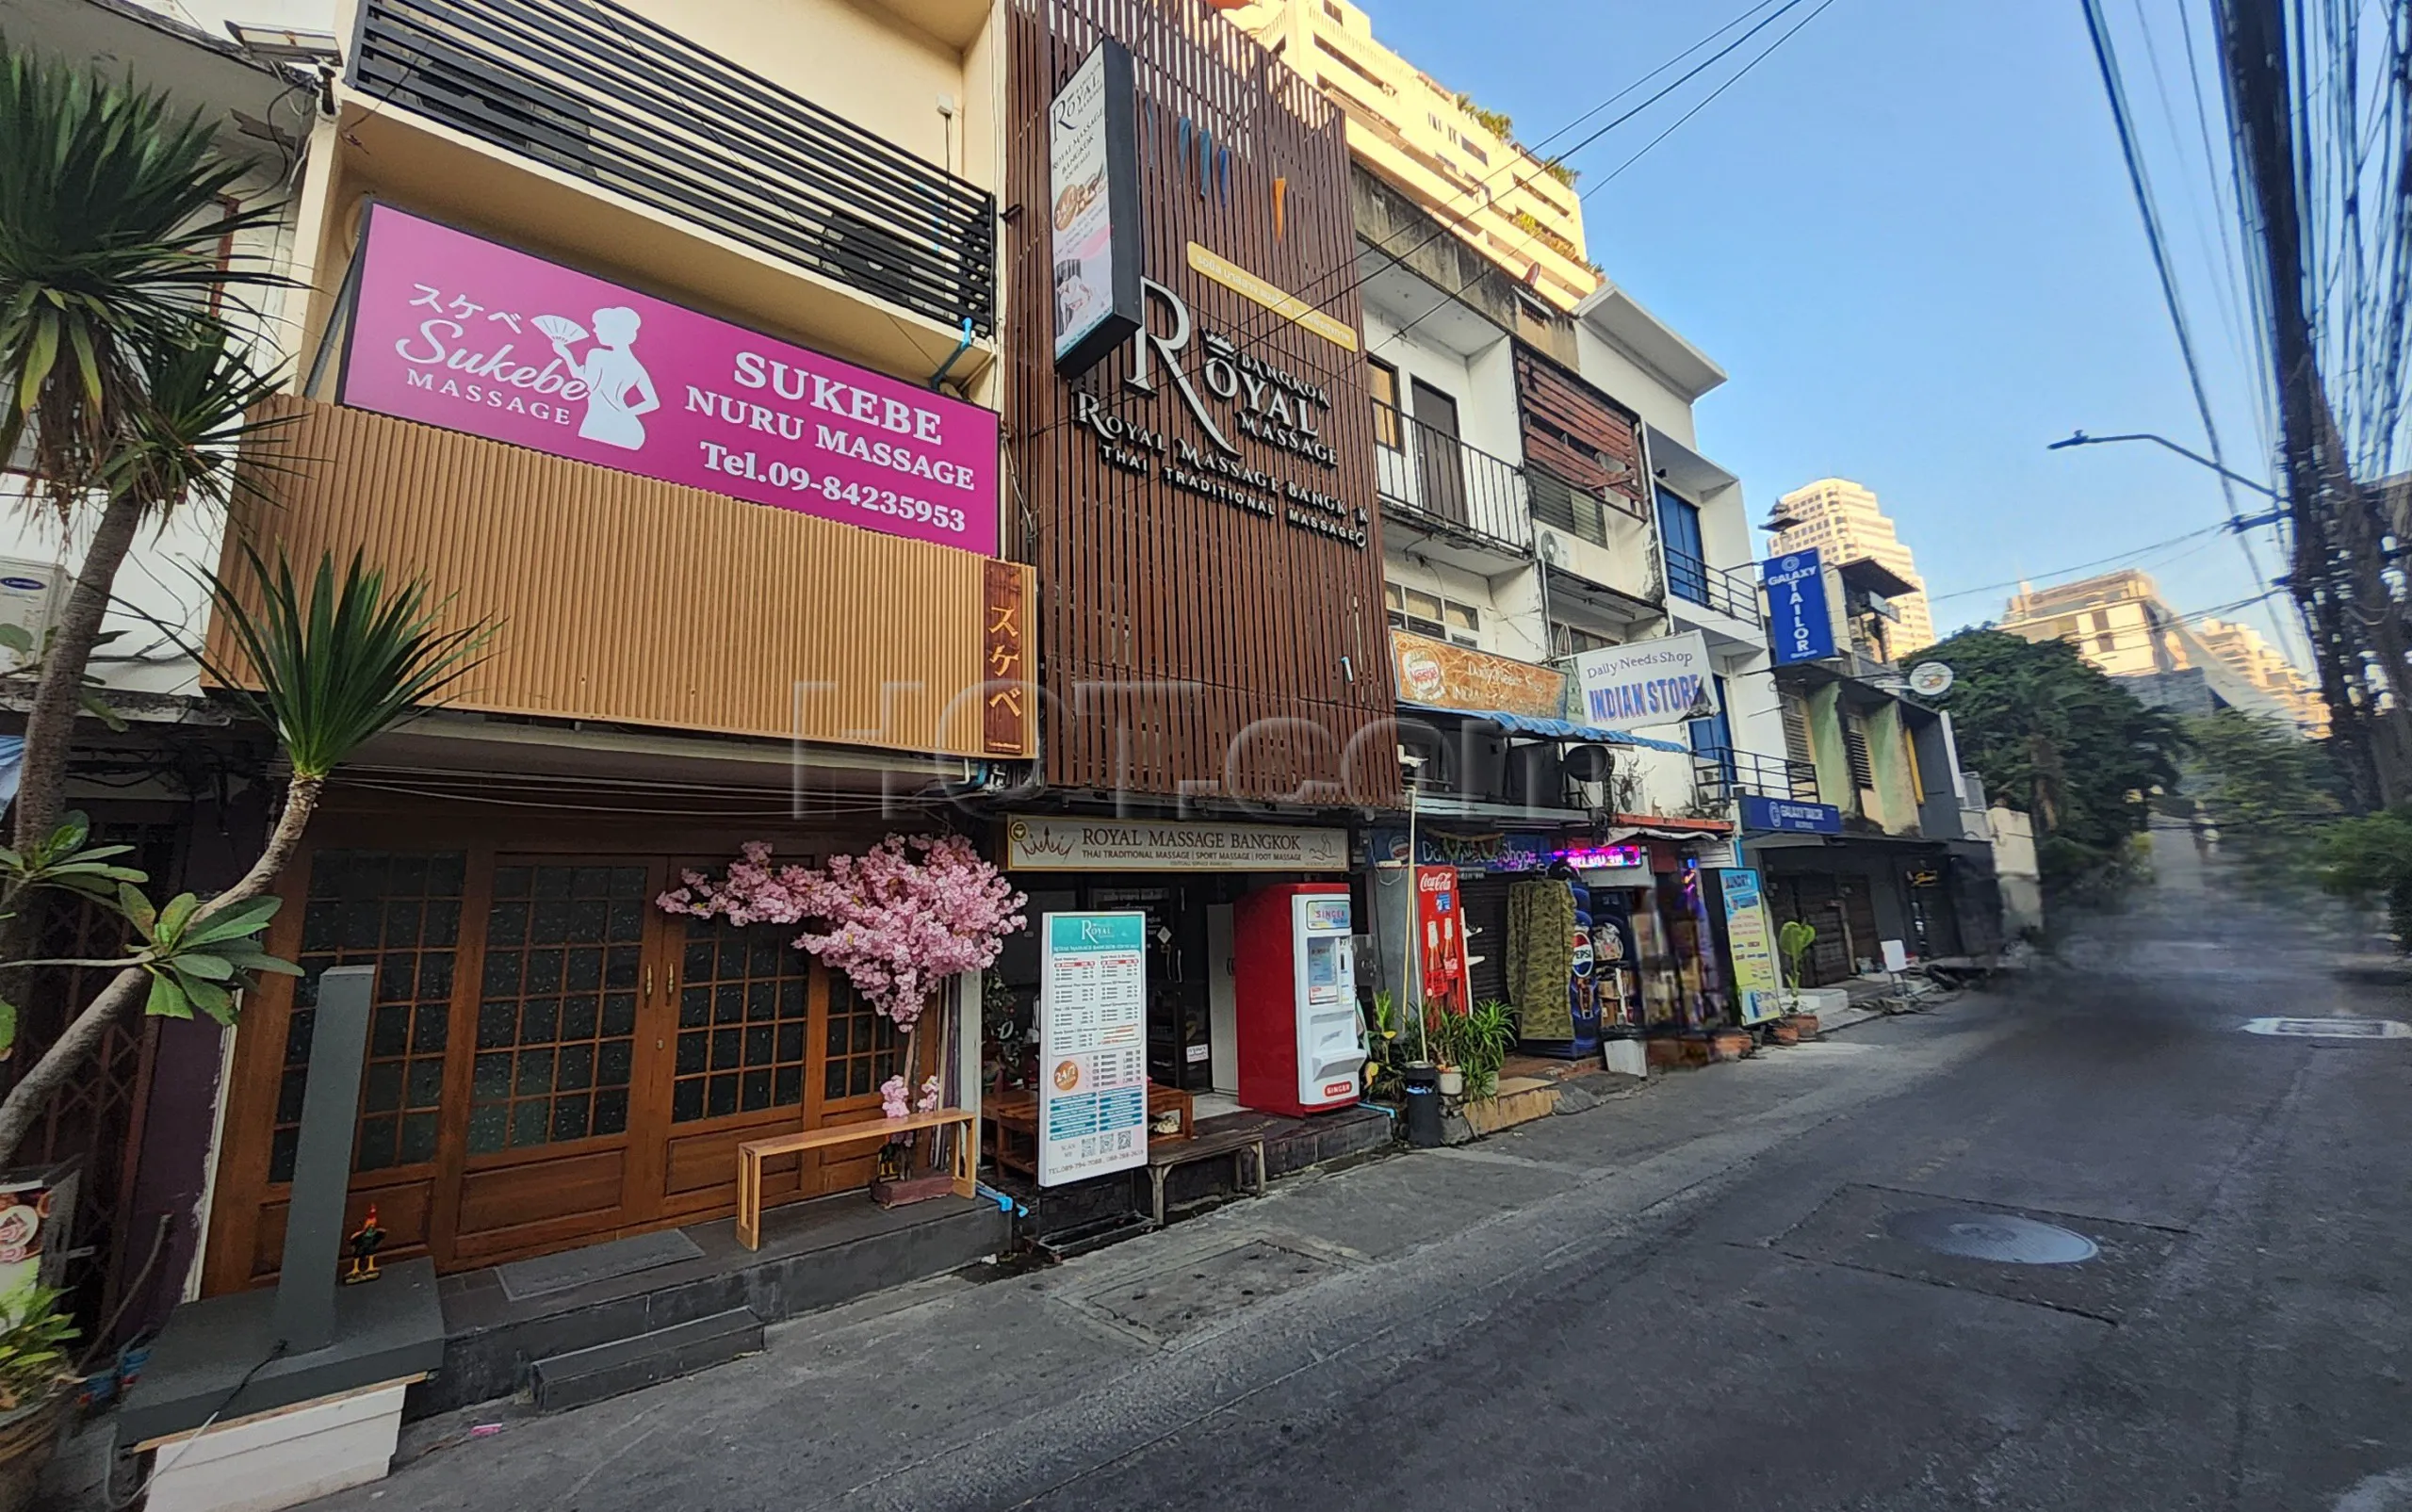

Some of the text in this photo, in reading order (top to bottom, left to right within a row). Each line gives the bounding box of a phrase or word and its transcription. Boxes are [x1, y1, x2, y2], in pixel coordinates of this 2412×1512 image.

[410, 283, 523, 334] スケベ
[395, 318, 591, 404] Sukebe
[1124, 276, 1320, 458] ROYAL
[1240, 352, 1329, 408] BANGKOK
[406, 367, 572, 427] MASSAGE
[733, 350, 943, 447] SUKEBE
[684, 383, 975, 492] NURU MASSAGE
[1077, 391, 1167, 452] ROYAL
[1177, 438, 1279, 492] MASSAGE
[1238, 411, 1338, 466] MASSAGE
[700, 439, 967, 533] Tel.09-84235953
[1102, 445, 1355, 541] THAI TRADITIONAL MASSAGE
[1768, 565, 1817, 586] GALAXY
[1787, 579, 1809, 652] TAILOR
[988, 605, 1021, 718] スケベ
[1588, 650, 1693, 679] Daily Needs Shop
[1589, 682, 1646, 722] INDIAN
[1083, 828, 1301, 850] ROYAL MASSAGE BANGKOK
[1083, 850, 1301, 861] THAI TRADITIONAL MASSAGE SPORT MASSAGE FOOT MASSAGE
[1082, 919, 1112, 944] ROYAL
[1327, 1082, 1350, 1095] SINGER
